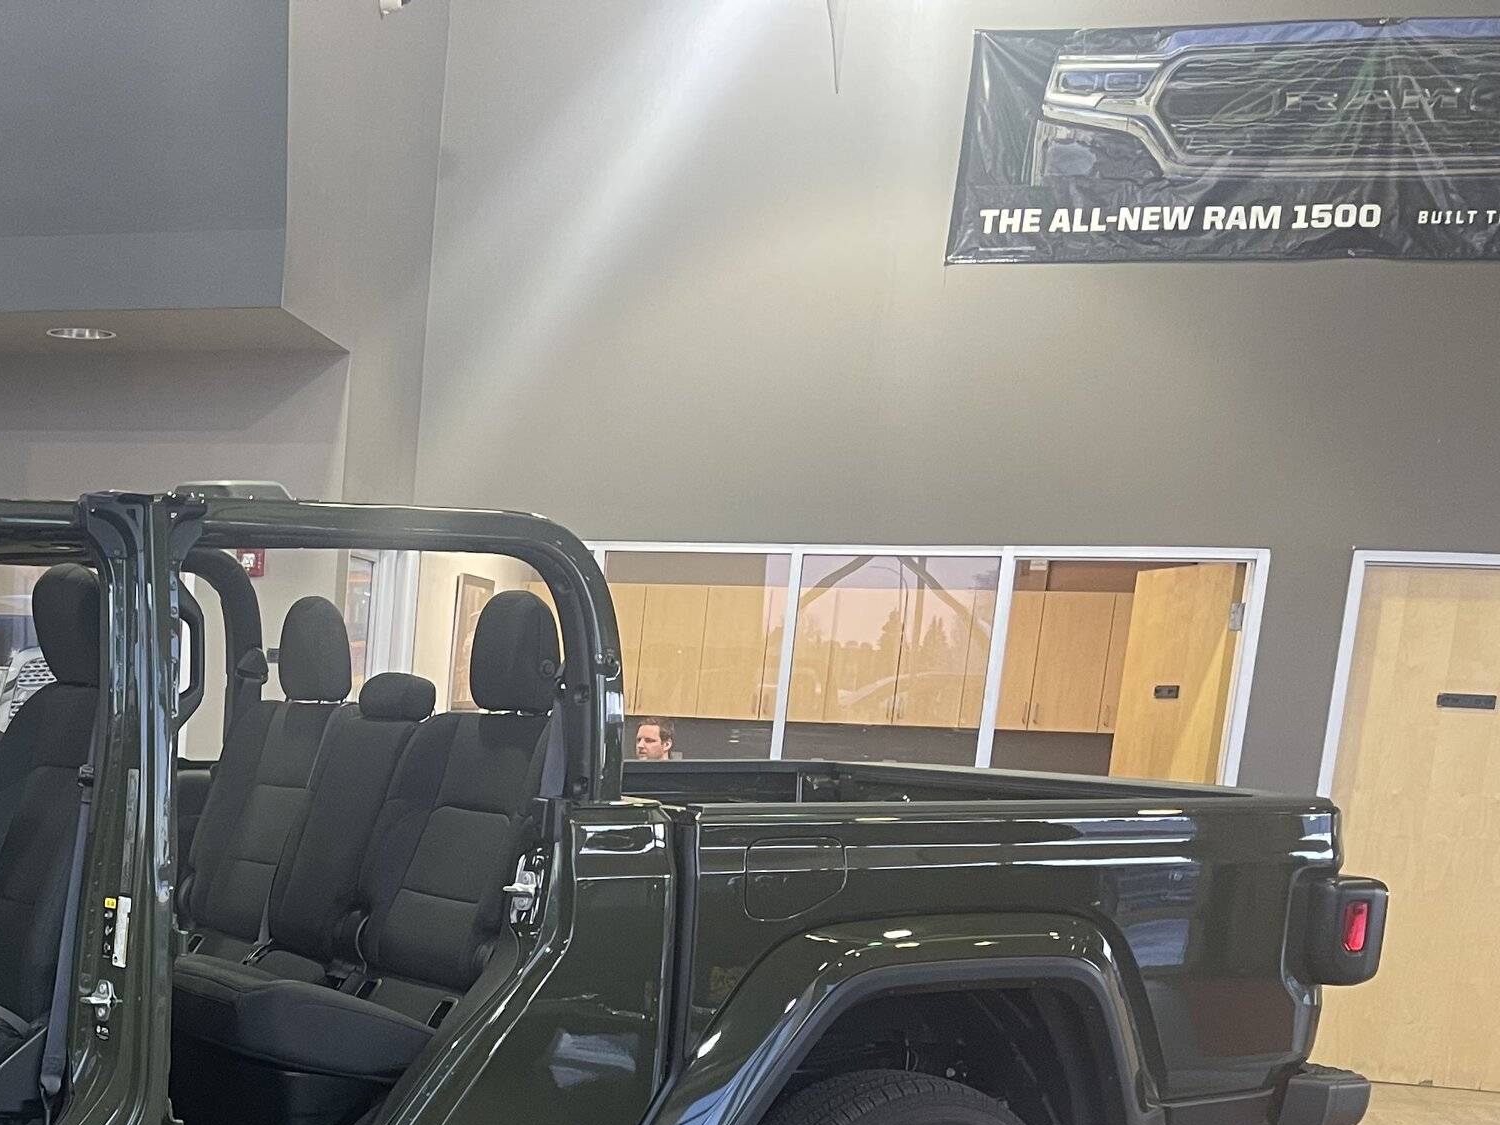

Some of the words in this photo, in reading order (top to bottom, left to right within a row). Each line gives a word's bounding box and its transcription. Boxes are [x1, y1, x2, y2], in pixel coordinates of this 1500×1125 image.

[1284, 87, 1460, 111] RAM
[979, 208, 1042, 234] THE
[1048, 206, 1194, 233] ALL-NEW
[1202, 205, 1283, 230] RAM
[1291, 203, 1382, 229] 1500
[1417, 209, 1478, 225] BUILT
[1486, 209, 1500, 225] T
